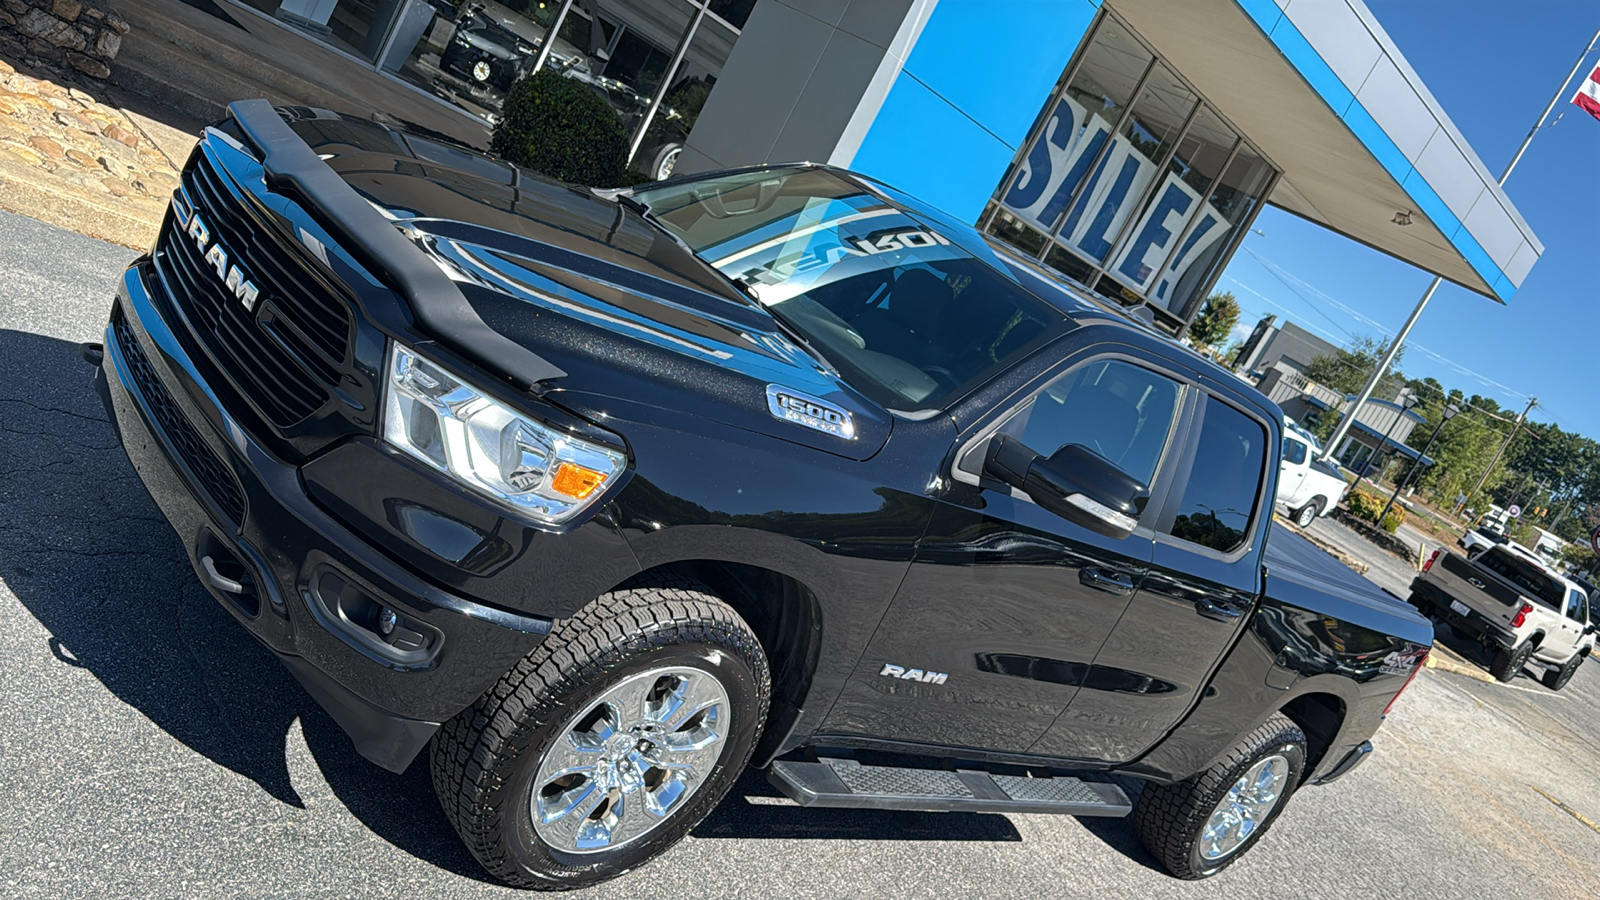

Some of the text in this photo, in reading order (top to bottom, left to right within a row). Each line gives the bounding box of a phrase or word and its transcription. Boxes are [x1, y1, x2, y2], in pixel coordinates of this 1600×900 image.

[1003, 96, 1219, 301] SALE!
[187, 213, 260, 313] RAM
[778, 393, 843, 426] 1500
[879, 662, 949, 685] RAM
